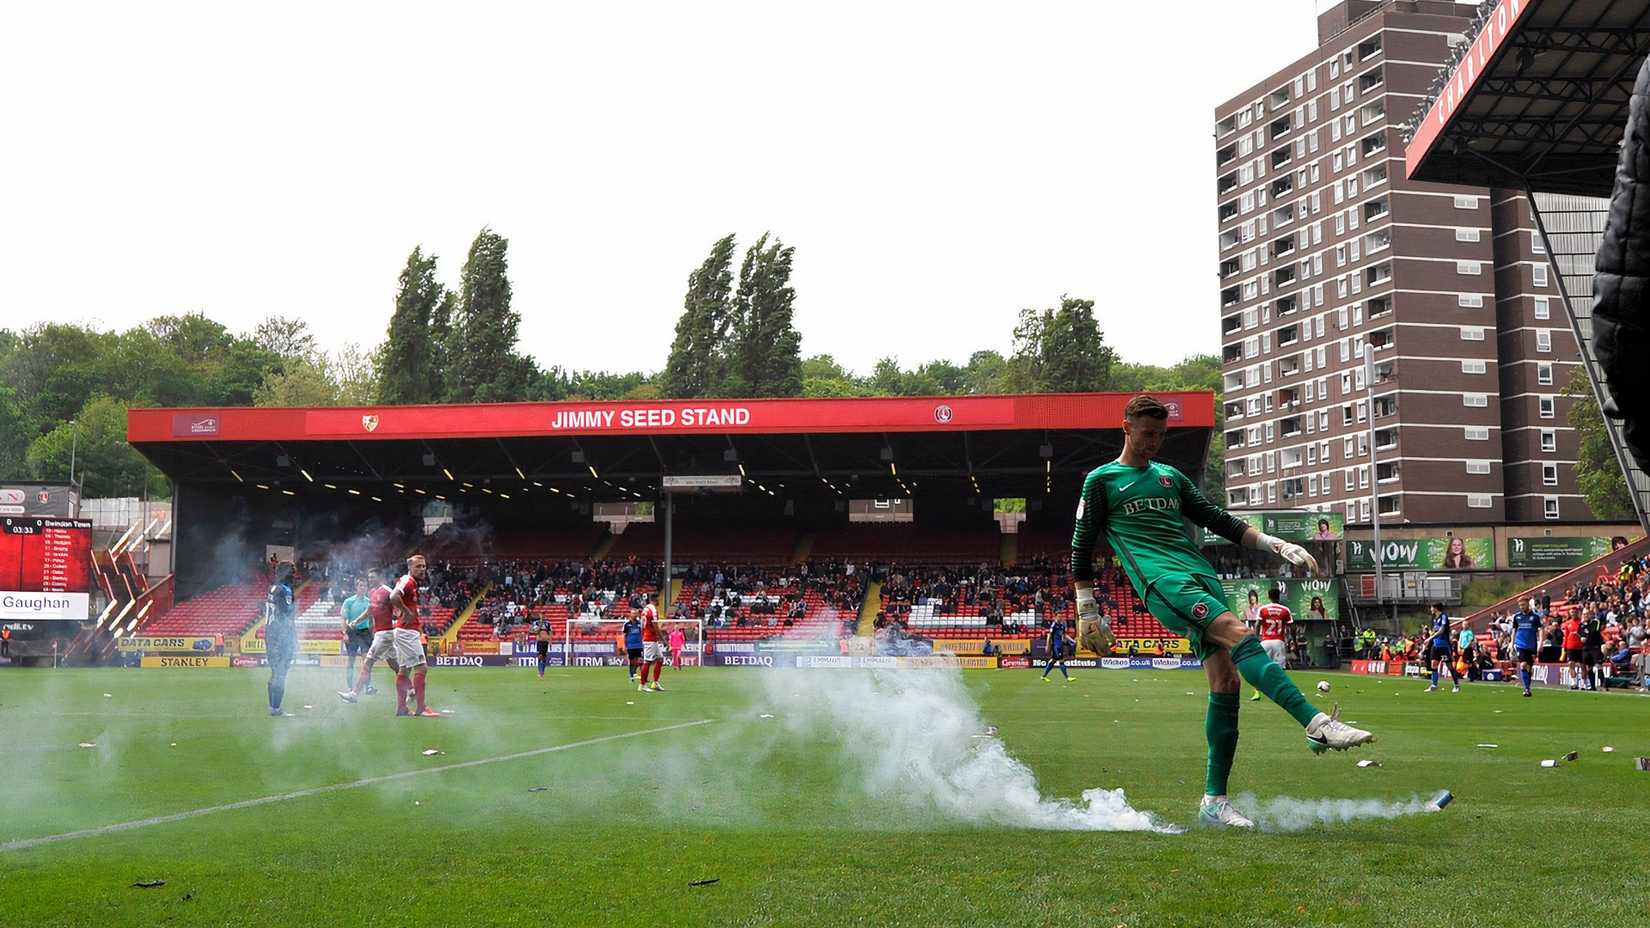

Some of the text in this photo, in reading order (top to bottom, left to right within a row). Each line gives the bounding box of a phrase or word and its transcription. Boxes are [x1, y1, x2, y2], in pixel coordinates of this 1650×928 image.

[1438, 0, 1519, 124] CHARLTON
[552, 409, 750, 428] JIMMY SEED STAND
[1122, 496, 1180, 515] BETDA
[6, 518, 12, 526] 0
[36, 519, 42, 527] 0
[44, 519, 91, 529] Swindon Town
[12, 526, 33, 534] 03:33
[1369, 541, 1419, 564] WOW
[1301, 580, 1332, 592] WOW
[2, 596, 70, 611] Gaughan
[120, 638, 185, 648] DATA CARS
[1116, 639, 1180, 649] ATA CARS
[160, 657, 209, 667] STANLEY
[436, 655, 484, 667] BETDAQ
[575, 656, 603, 667] ITRM
[607, 656, 625, 667] sky
[724, 656, 773, 668] BETDAQ
